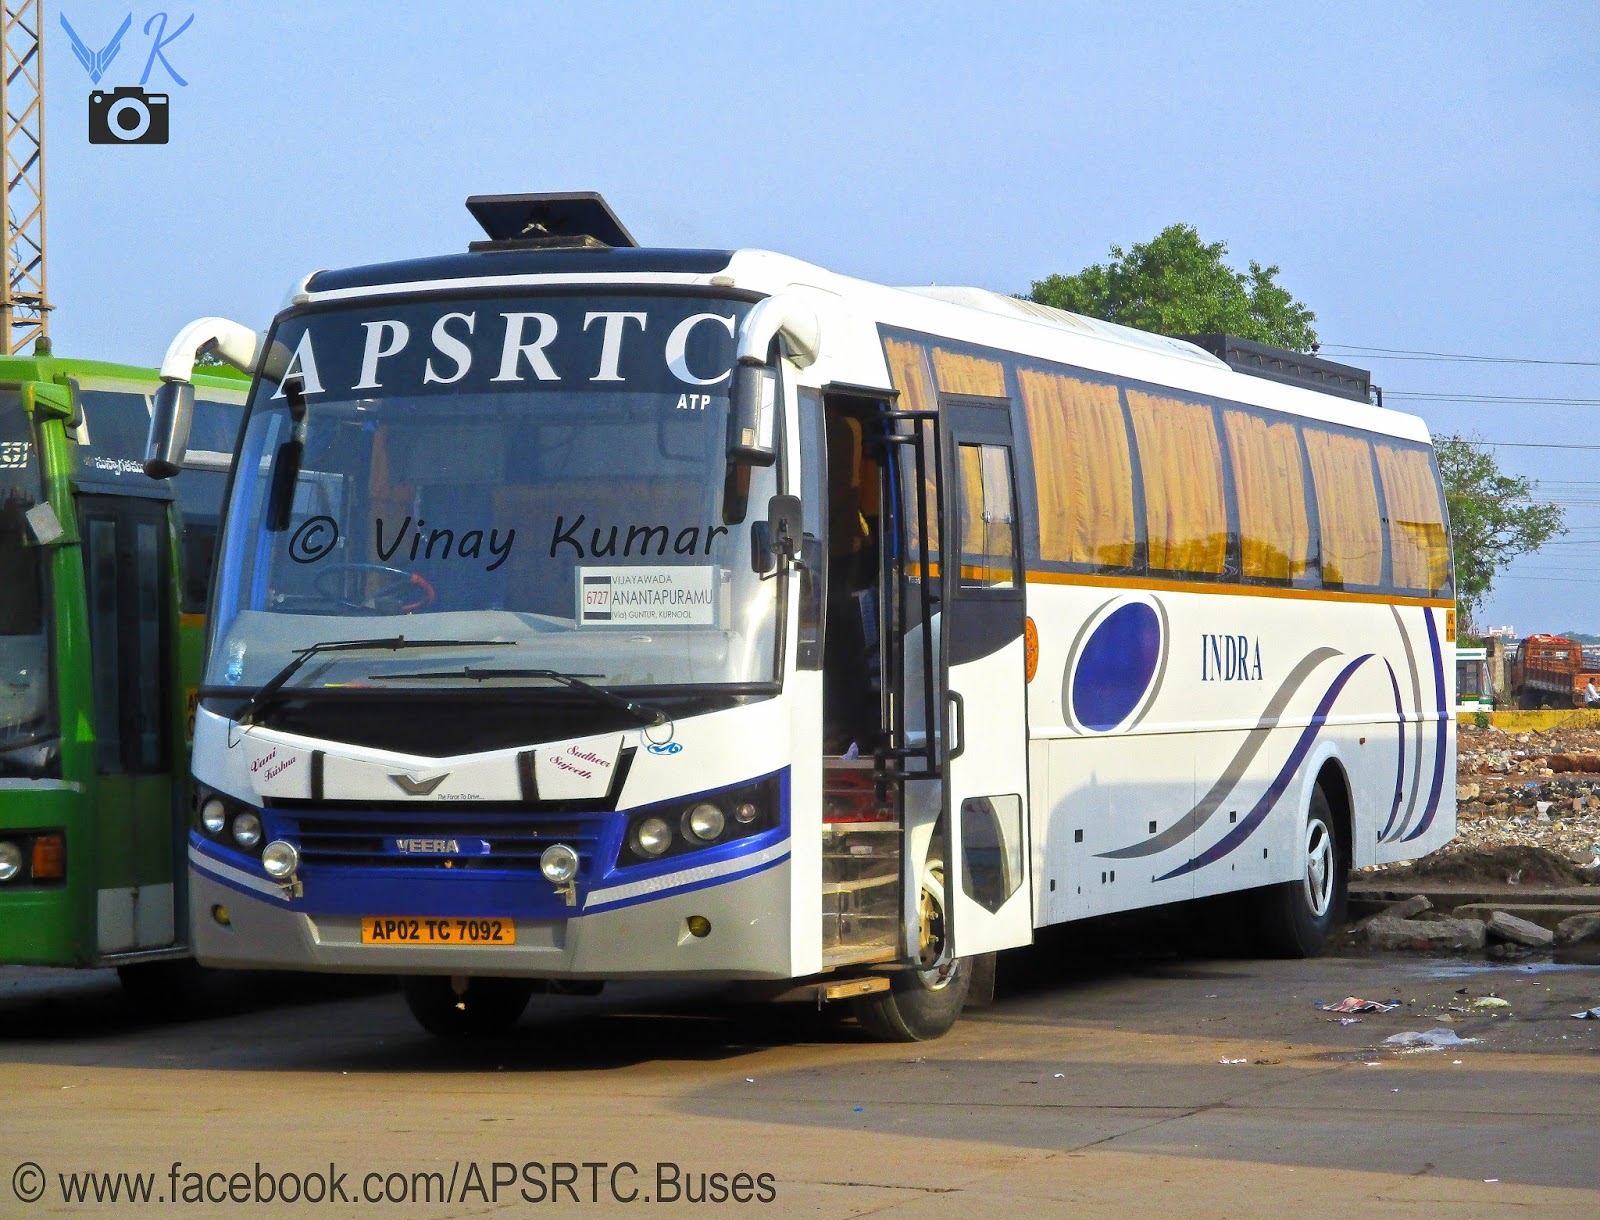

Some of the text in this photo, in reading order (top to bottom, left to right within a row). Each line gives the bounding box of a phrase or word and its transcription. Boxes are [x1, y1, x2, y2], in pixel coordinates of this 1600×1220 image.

[270, 310, 736, 400] APSRTC
[676, 393, 711, 411] ATP
[611, 575, 673, 584] VIJAYAWADA
[586, 591, 609, 605] 6727
[611, 589, 713, 605] ANANTAPURAMU
[659, 611, 692, 619] KURNOOL
[1201, 634, 1264, 681] INDRA
[396, 839, 459, 854] VEERA
[372, 920, 503, 941] AP02 TC 7092
